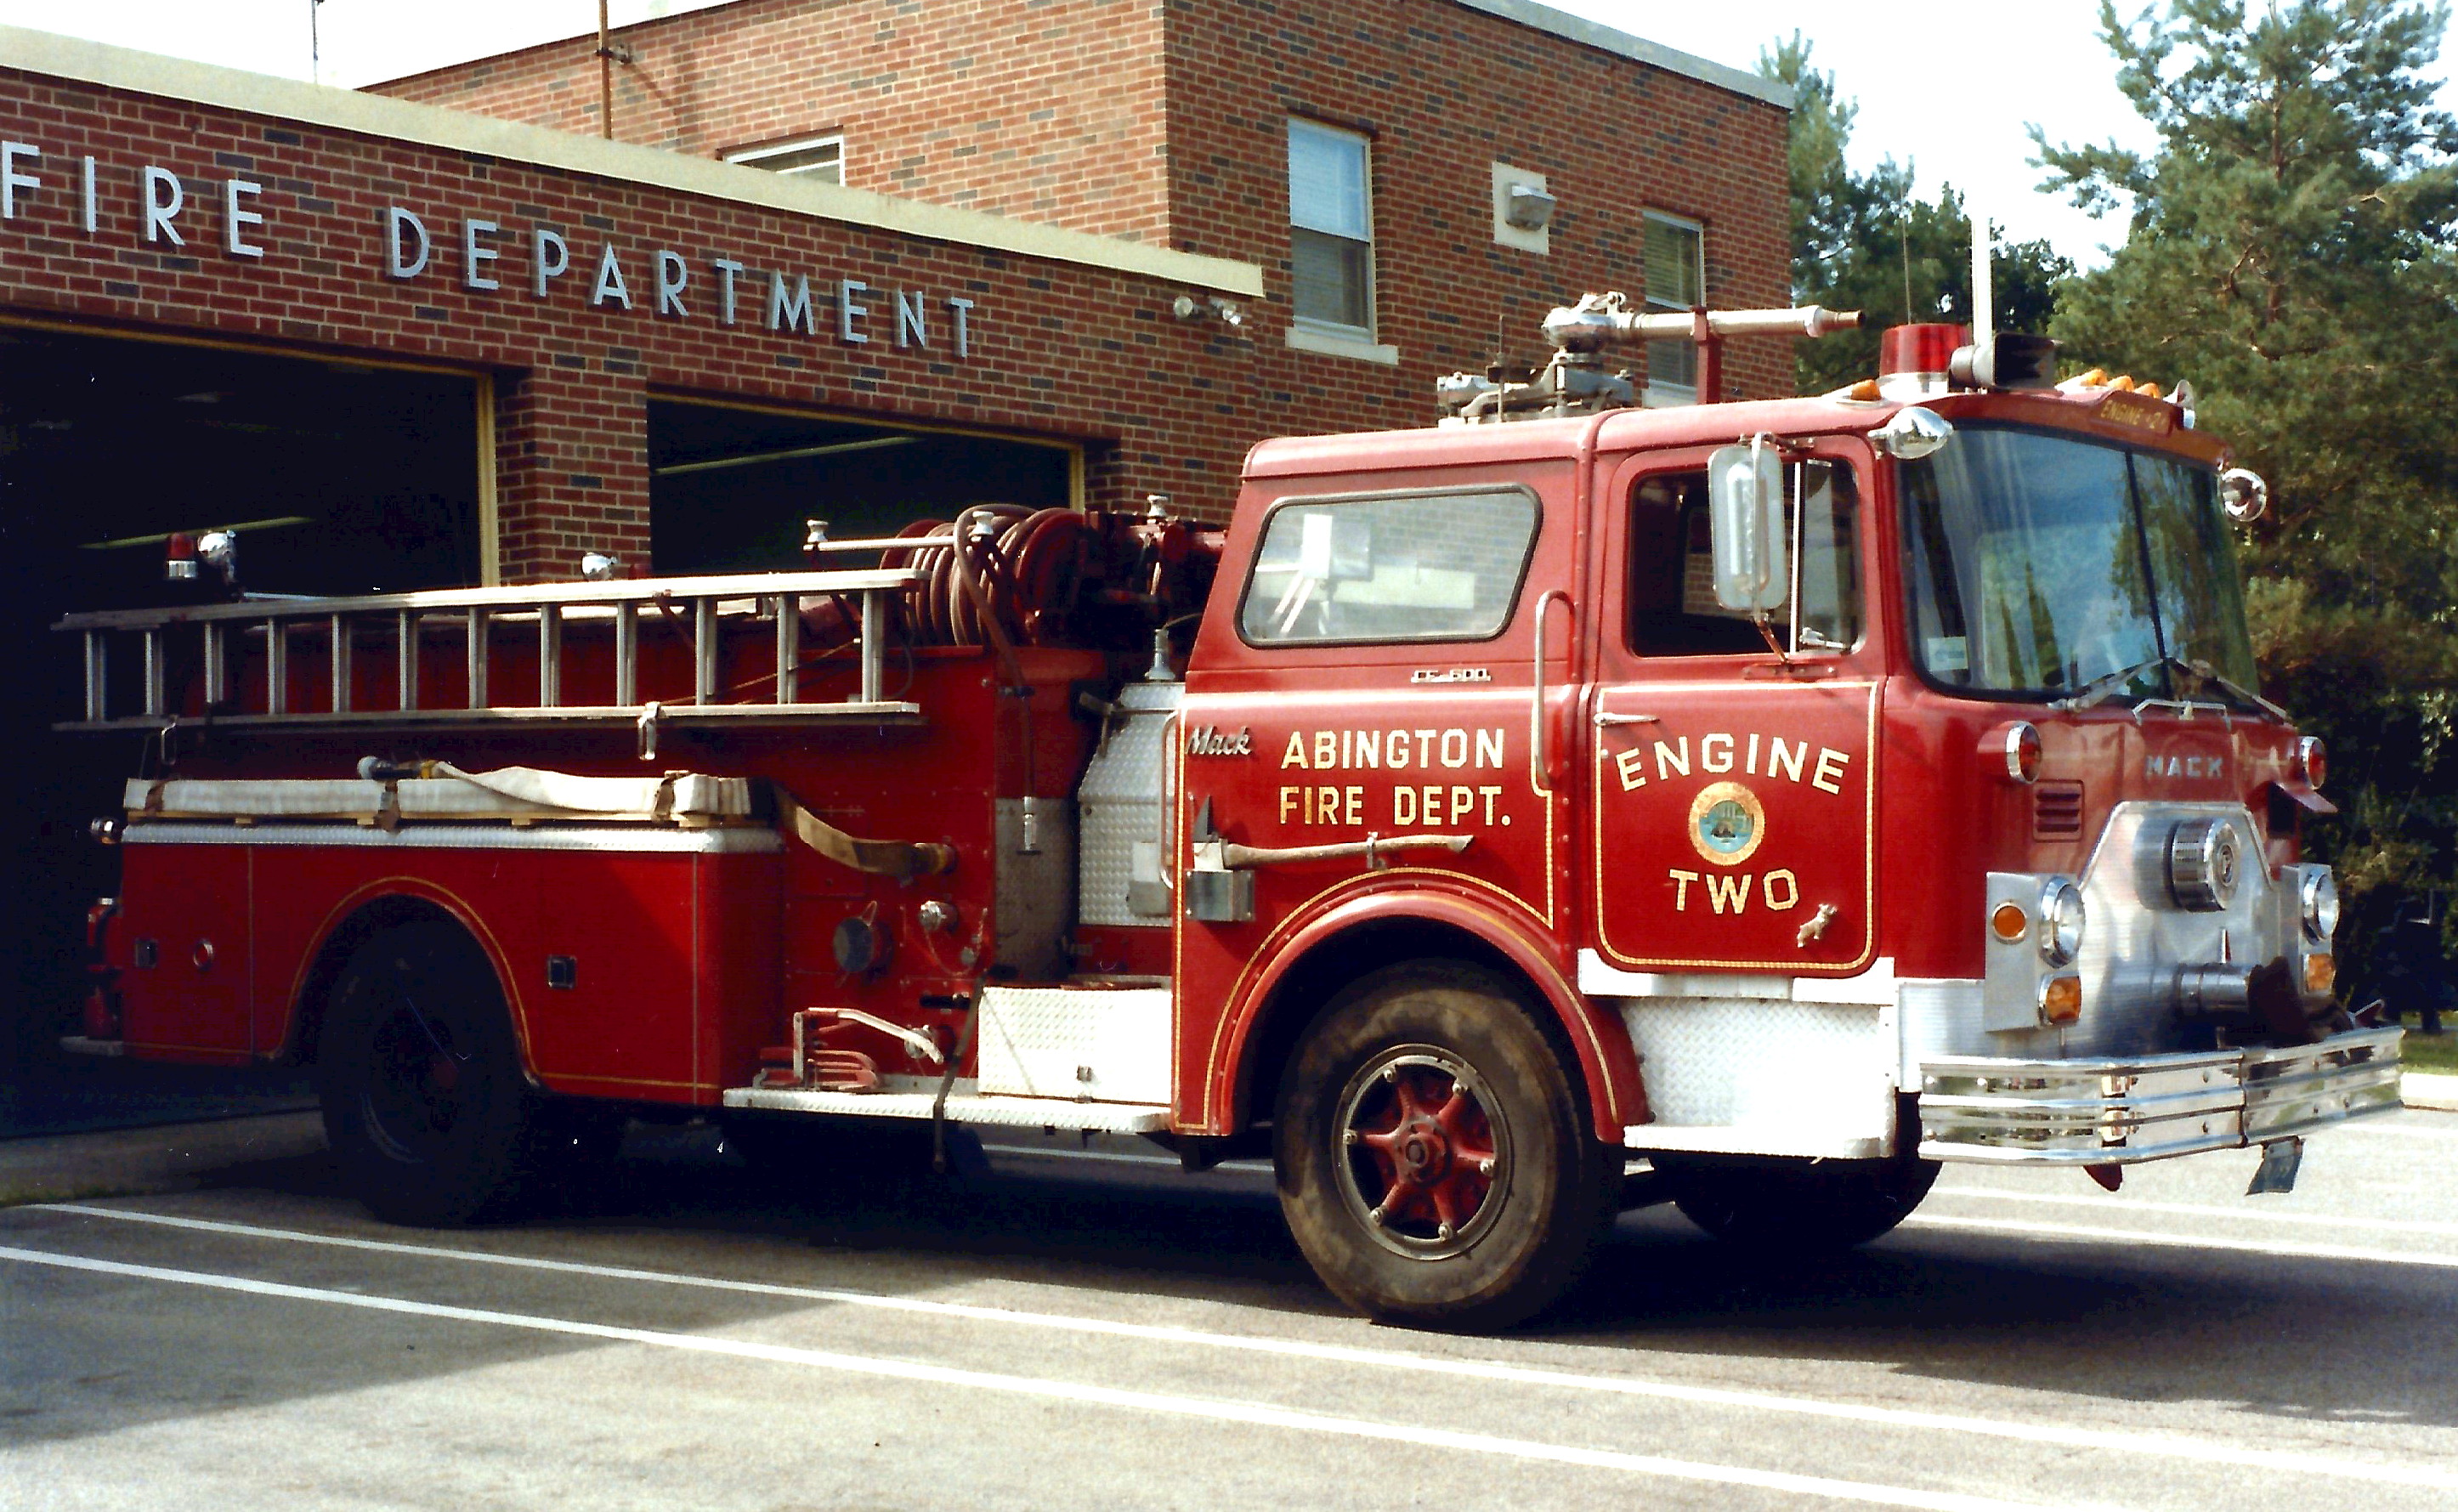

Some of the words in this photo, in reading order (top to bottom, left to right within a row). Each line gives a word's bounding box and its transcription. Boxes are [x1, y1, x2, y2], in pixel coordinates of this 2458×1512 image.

[2, 140, 265, 258] FIRE
[385, 207, 975, 358] DEPARTMENT
[2100, 399, 2144, 425] ENGINE
[1184, 725, 1251, 755] Mack
[1281, 728, 1504, 769] ABINGTON
[1615, 733, 1850, 796] ENGINE
[2145, 755, 2224, 779] MACK
[1279, 786, 1363, 825] FIRE
[1393, 786, 1512, 826] DEPT.
[1668, 868, 1799, 915] TWO
